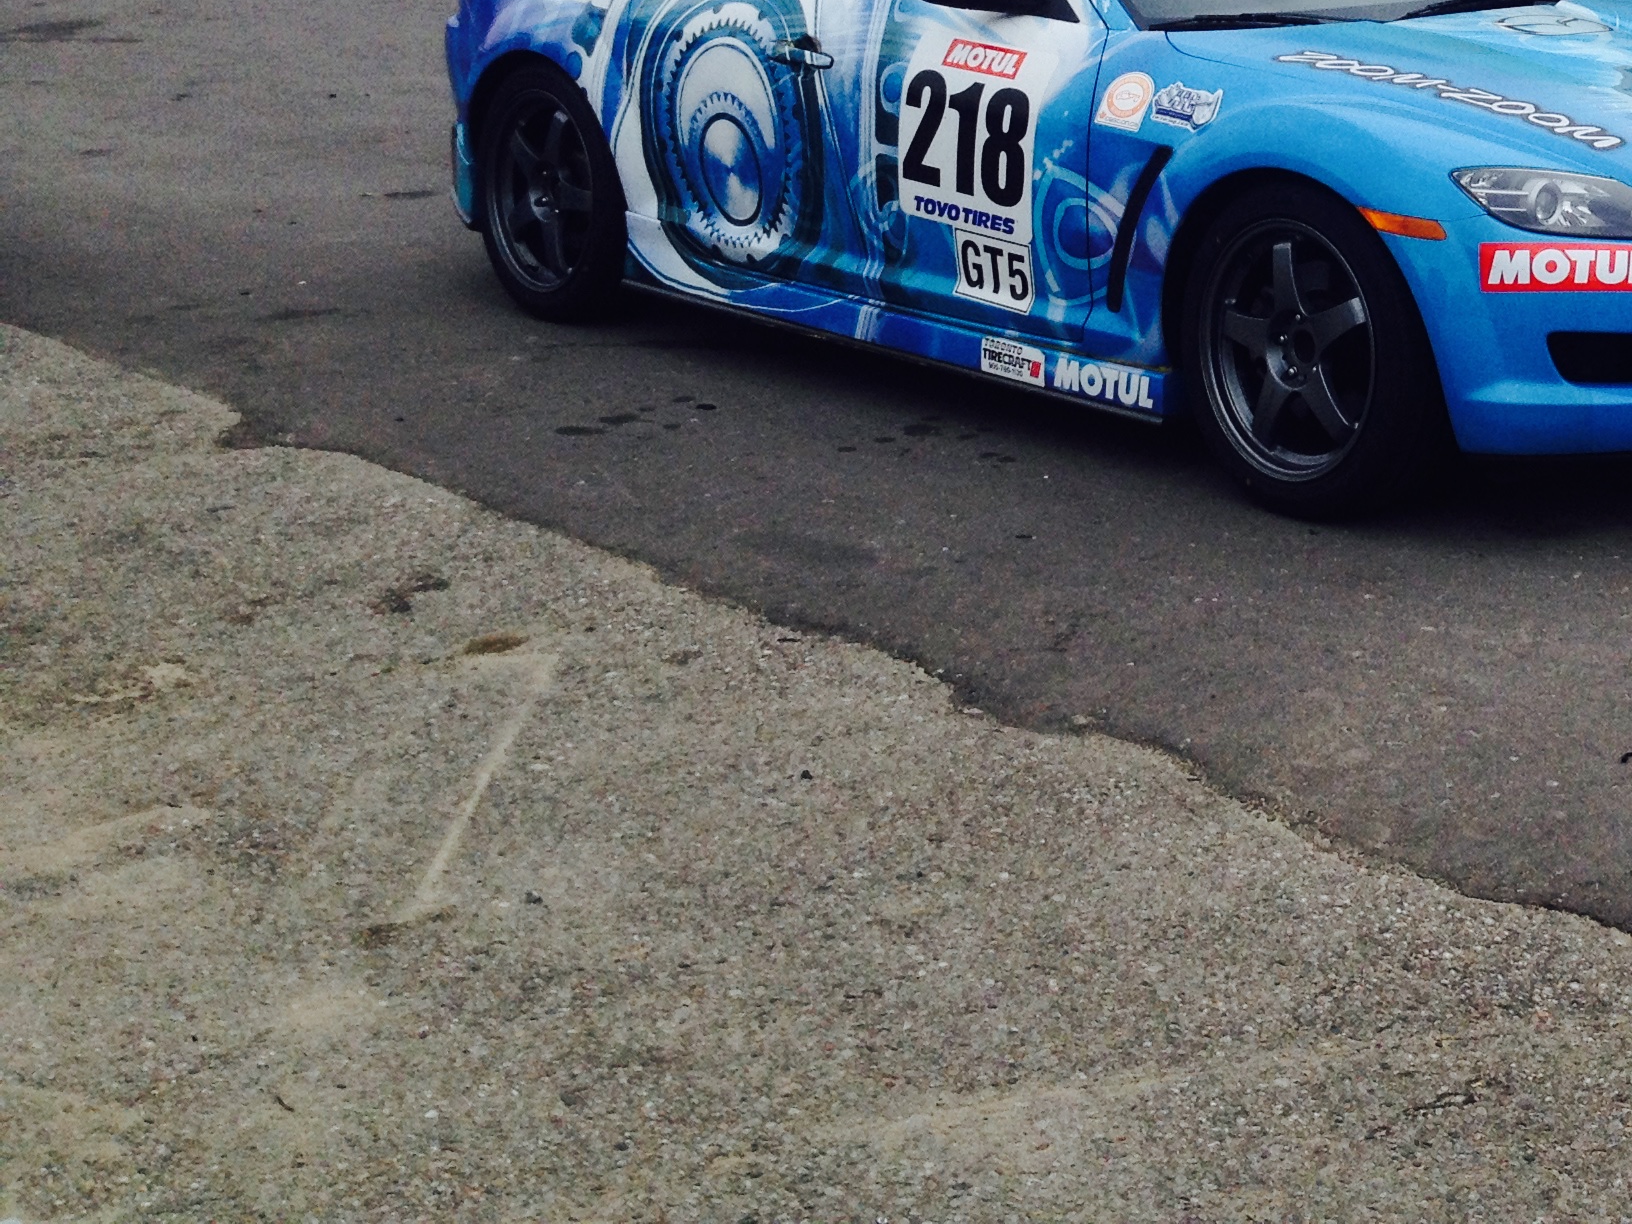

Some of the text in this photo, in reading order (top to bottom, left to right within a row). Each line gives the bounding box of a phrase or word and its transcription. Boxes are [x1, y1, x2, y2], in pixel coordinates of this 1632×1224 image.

[945, 42, 1021, 75] MOTUL
[902, 69, 1030, 208] 218
[914, 195, 1015, 235] TOYO TIRES
[961, 239, 1029, 301] GT5
[982, 347, 1032, 371] TIRECRAFT
[984, 337, 1023, 356] TORONTO
[1053, 354, 1154, 409] MOTUL
